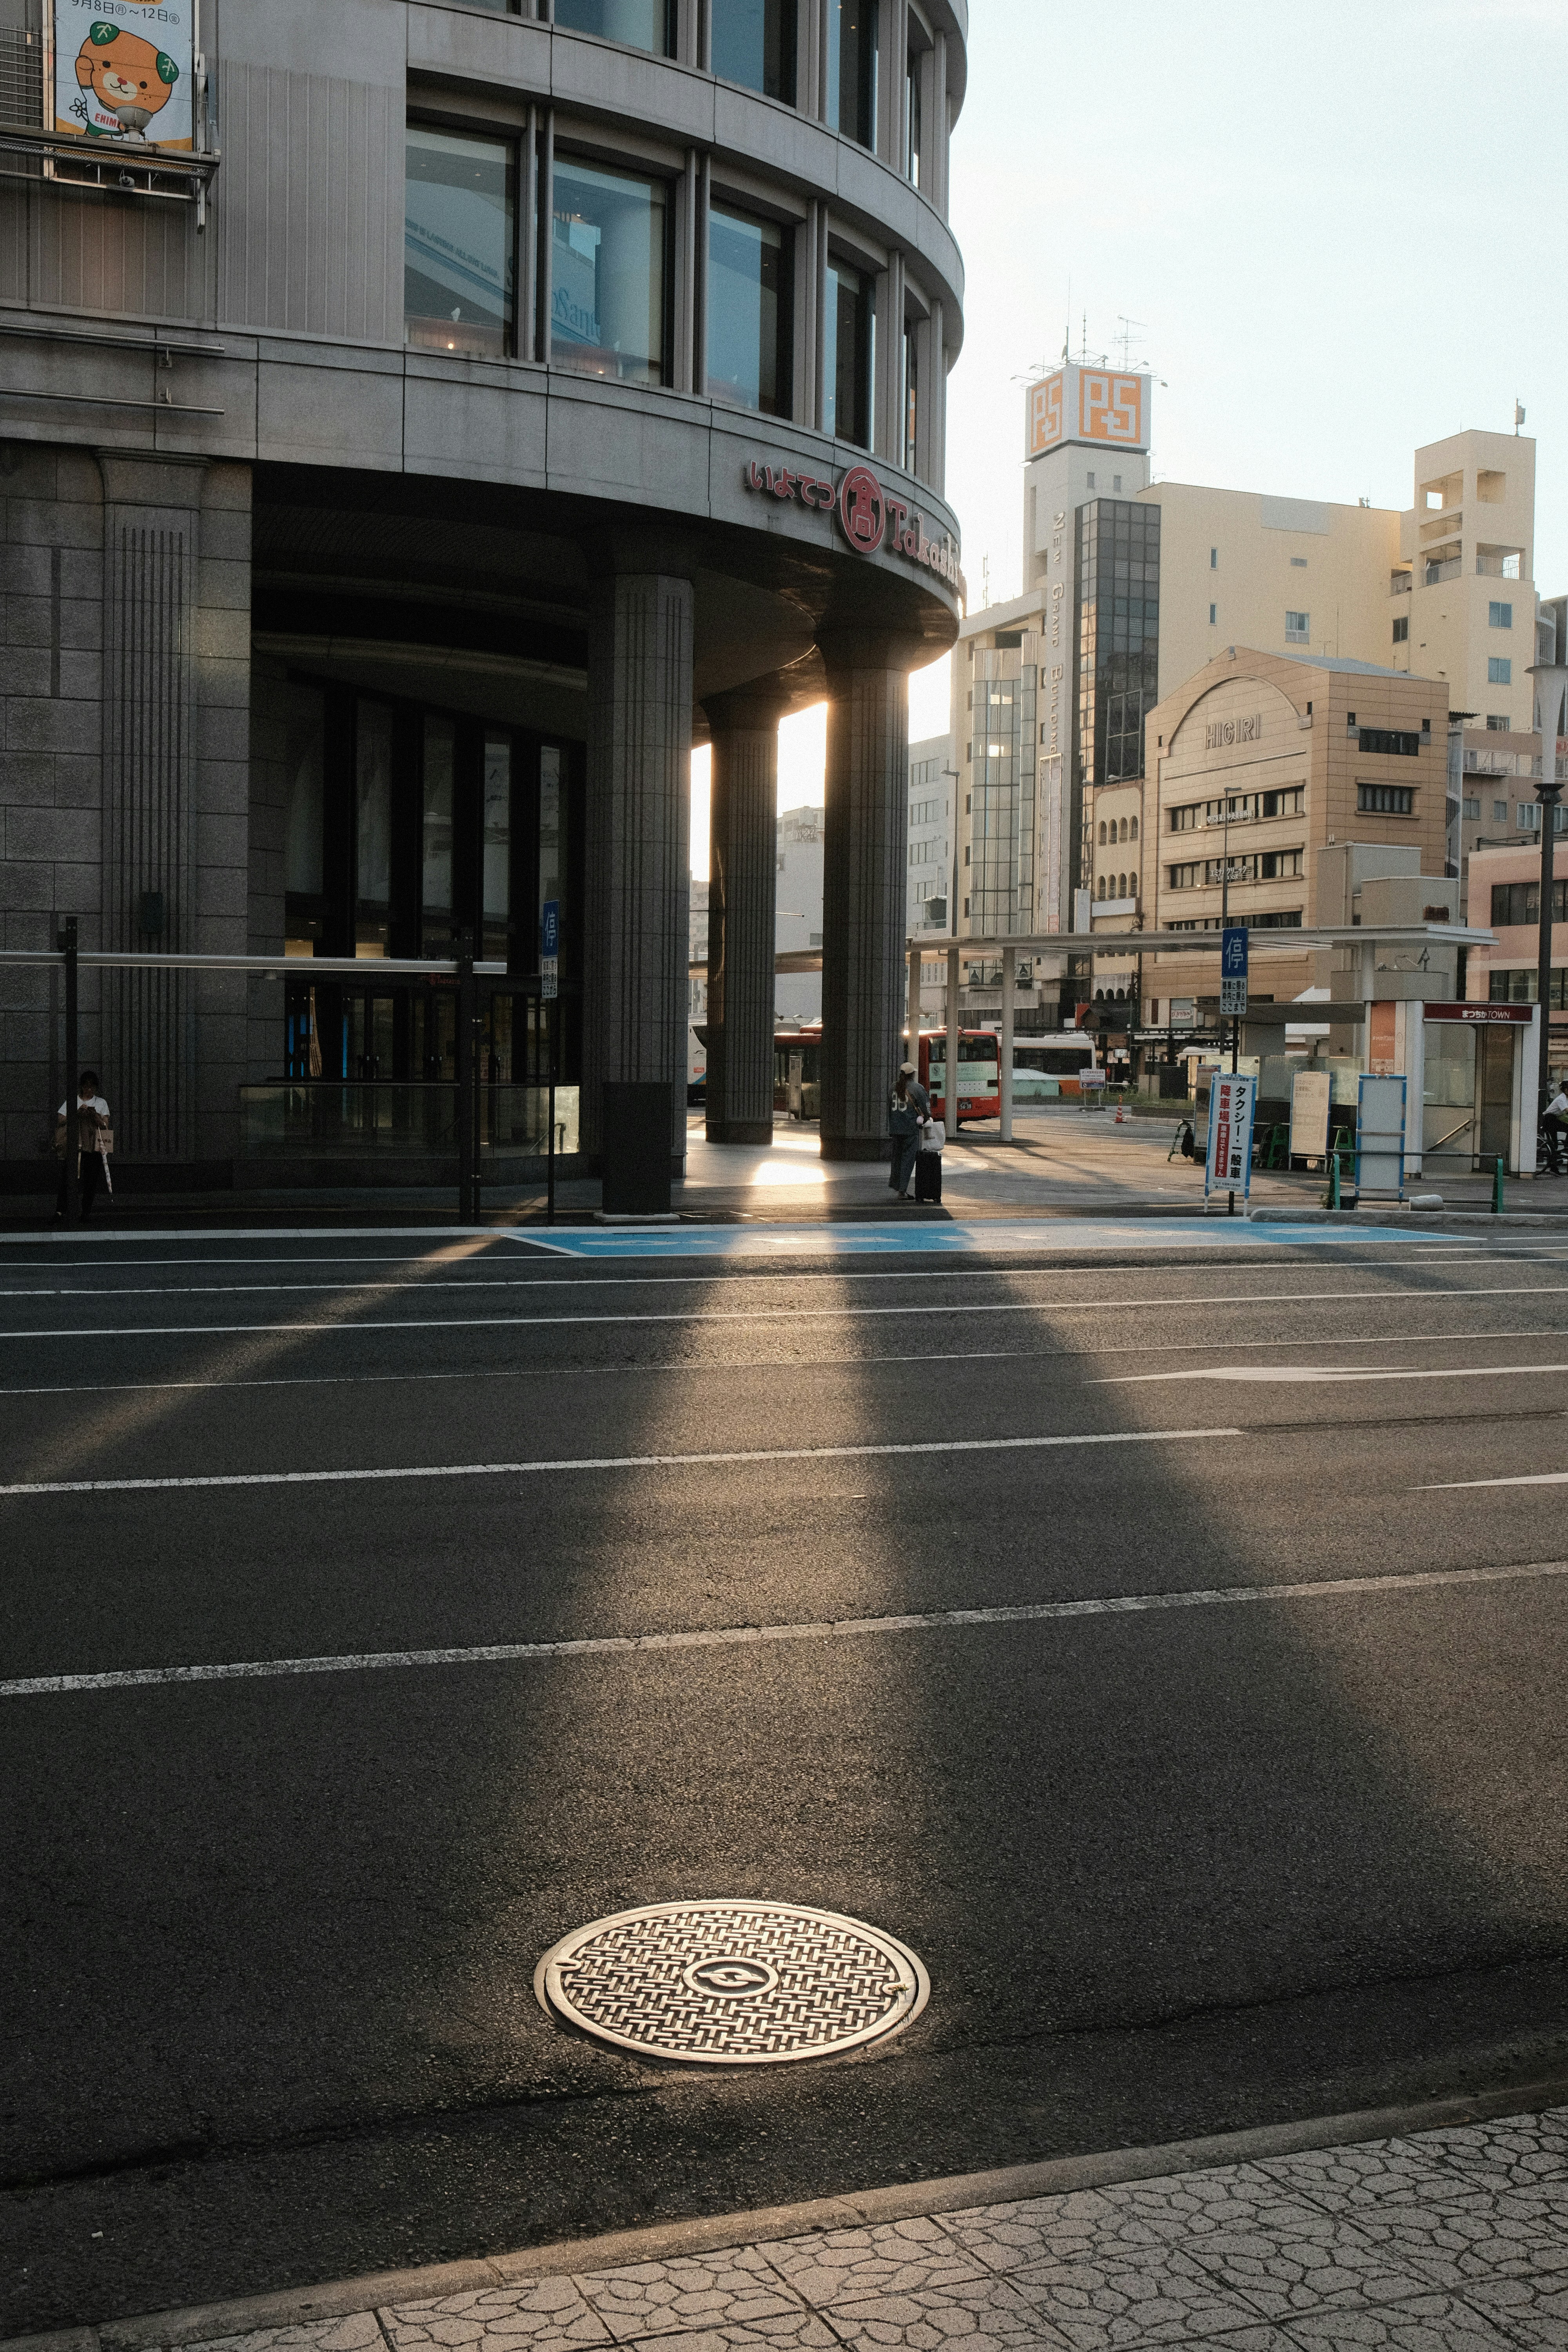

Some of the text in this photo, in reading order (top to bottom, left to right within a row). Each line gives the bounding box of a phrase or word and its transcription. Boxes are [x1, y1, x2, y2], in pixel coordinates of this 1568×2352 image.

[750, 461, 836, 510] いよてつ
[1050, 512, 1065, 754] NEW GRAND BUILDING
[1205, 715, 1261, 749] HIGIRI
[545, 911, 556, 946] 停
[1225, 937, 1243, 968] 停
[1222, 1002, 1245, 1012] ここまで
[1462, 1010, 1510, 1019] まつちかTOWN
[1218, 1084, 1231, 1123] 降車場
[1230, 1086, 1246, 1179] タクシー・一般車
